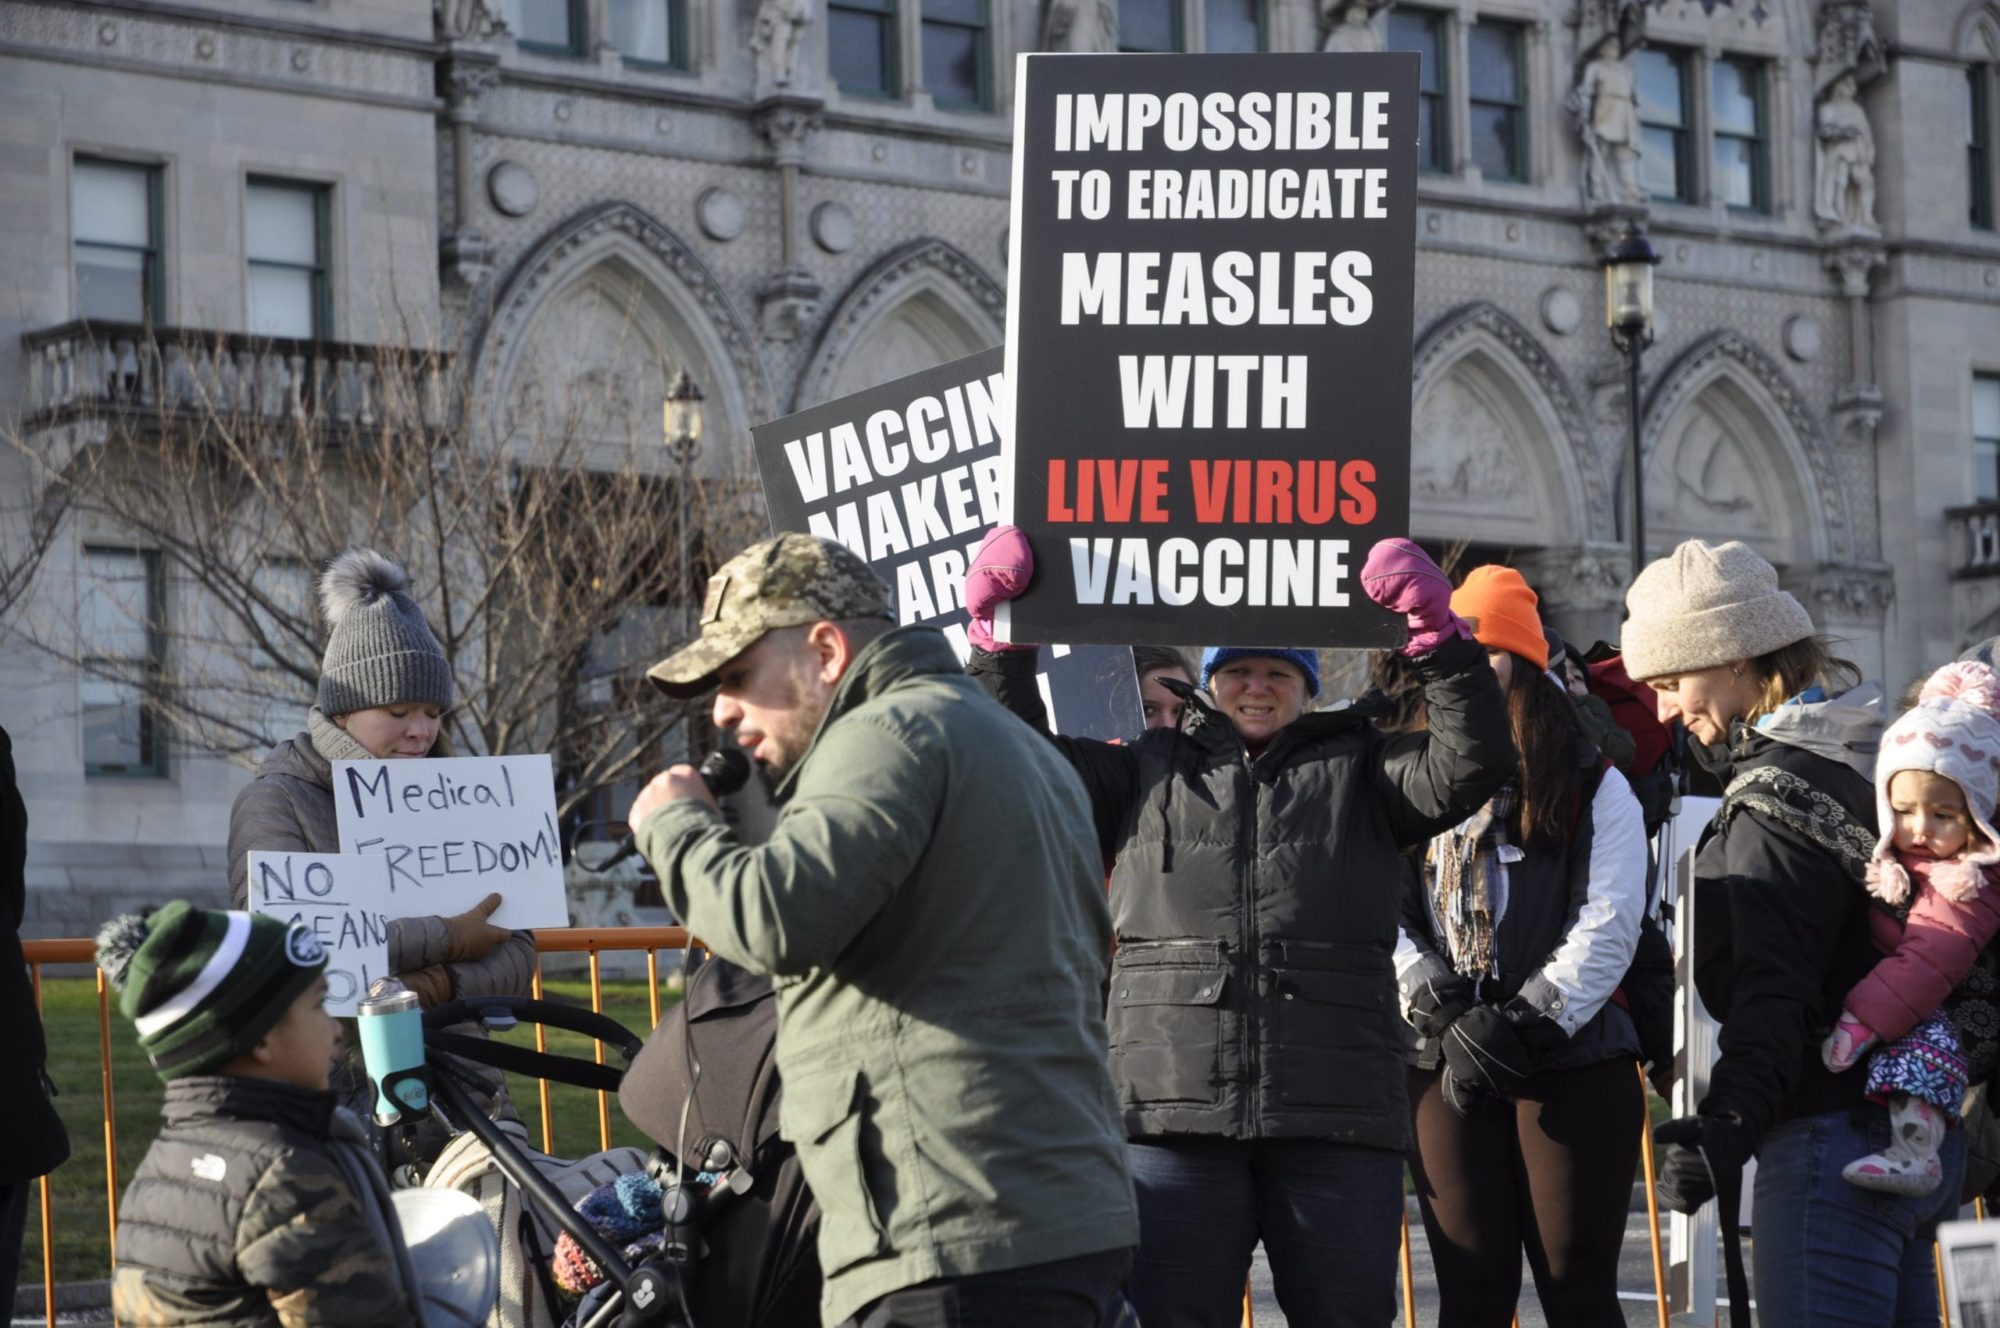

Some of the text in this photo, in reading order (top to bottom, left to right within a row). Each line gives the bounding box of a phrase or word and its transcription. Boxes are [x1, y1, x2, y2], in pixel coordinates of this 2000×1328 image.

[1054, 92, 1390, 152] IMPOSSIBLE
[1052, 168, 1388, 220] TO ERADICATE
[1060, 251, 1373, 326] MEASLES
[1118, 355, 1308, 429] WITH
[784, 372, 1003, 503] VACCIN
[808, 455, 1001, 563] MAKER
[1047, 459, 1377, 525] LIVE VIRUS
[897, 540, 981, 626] AR
[1069, 537, 1350, 607] VACCINE
[346, 765, 515, 818] Medical
[258, 856, 334, 901] NO
[256, 909, 388, 950] EANS
